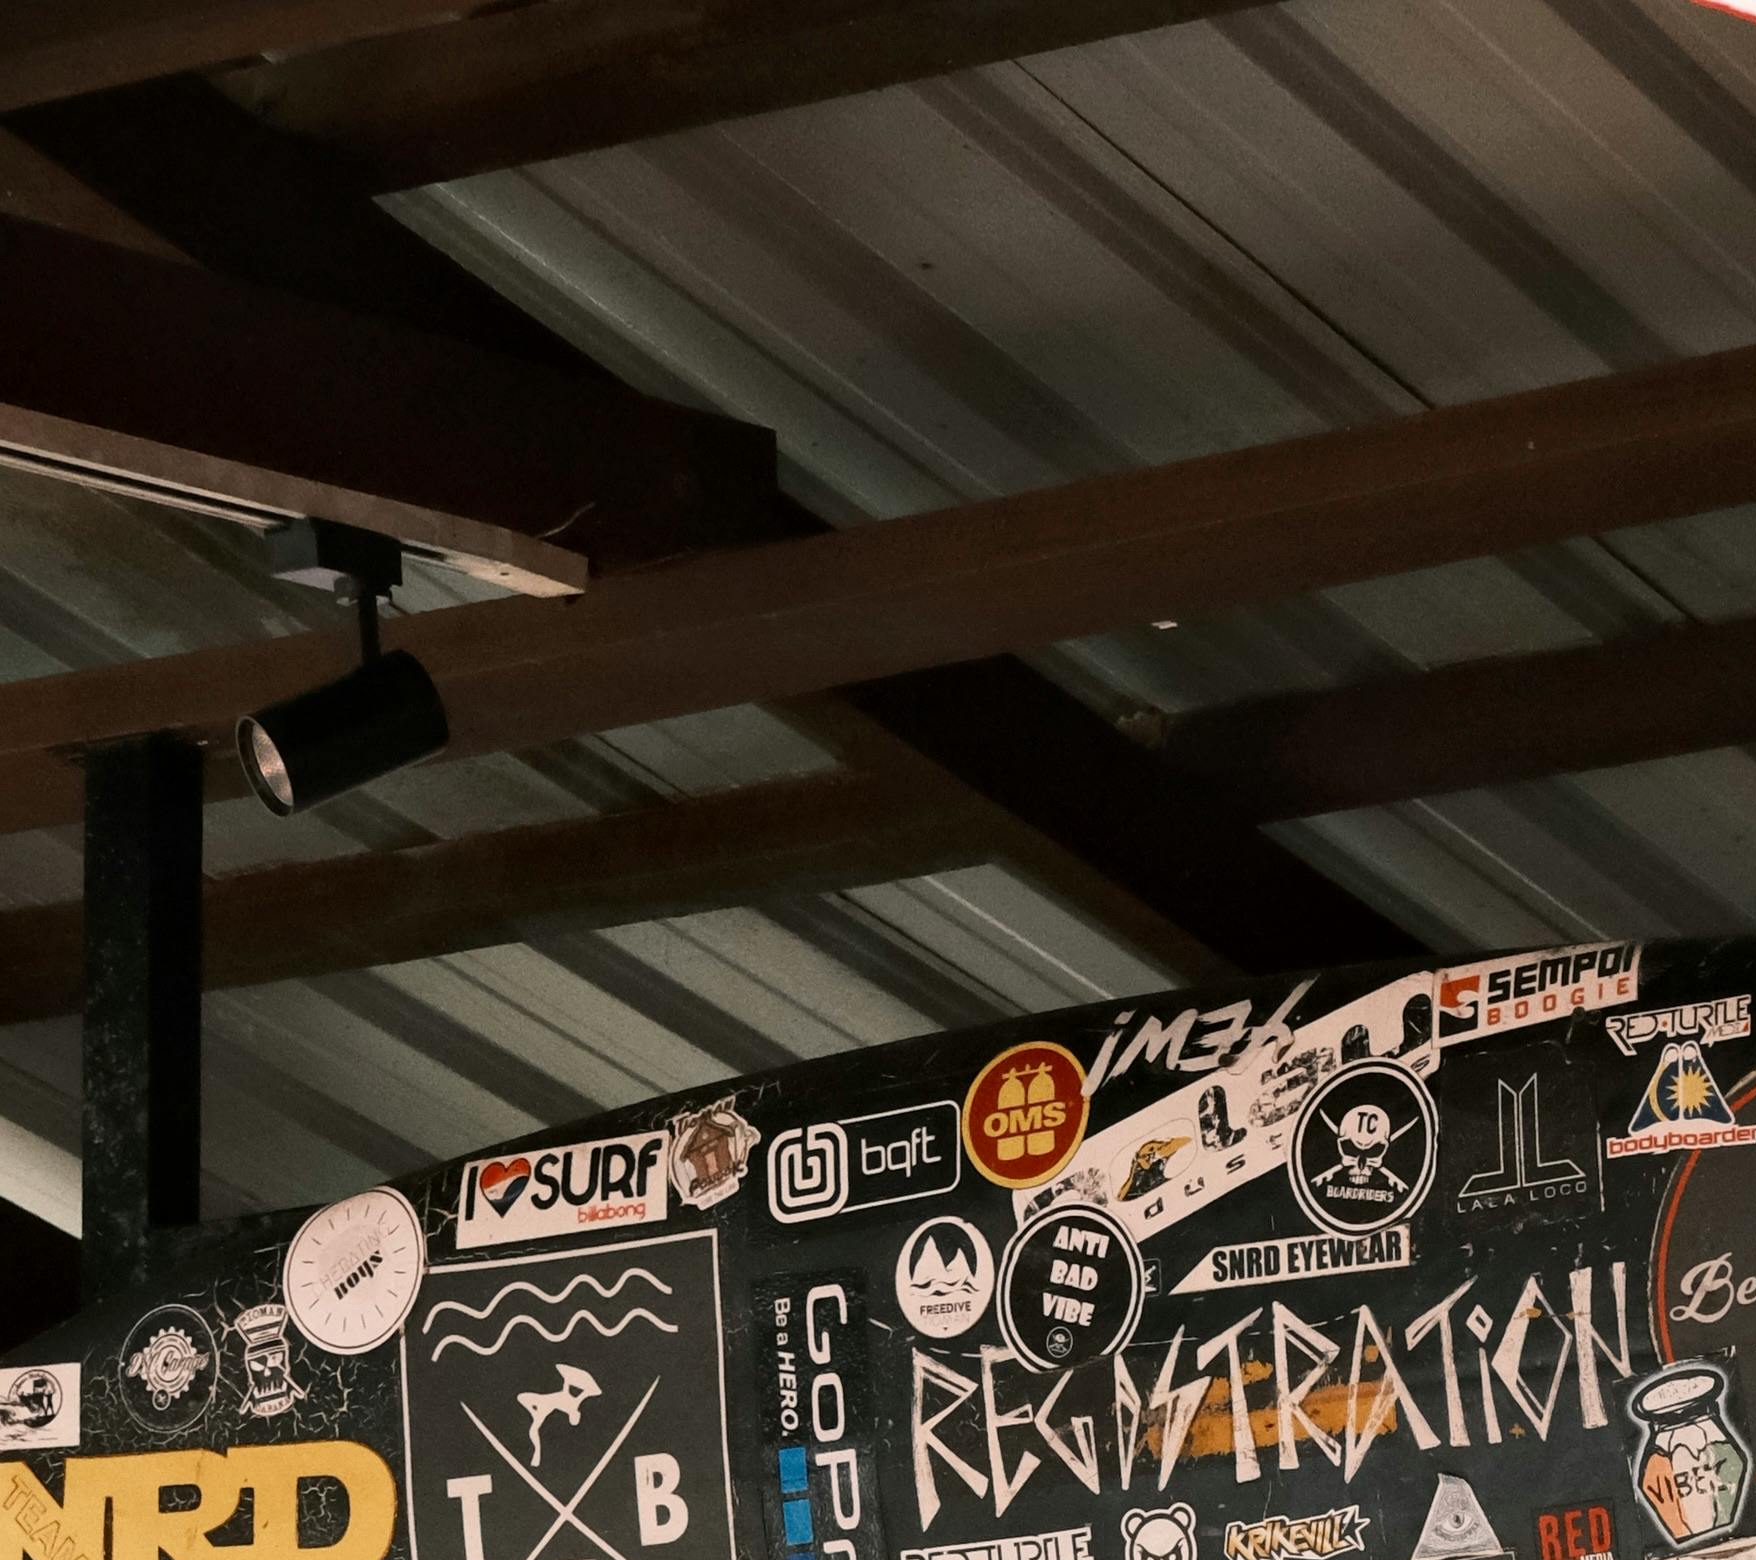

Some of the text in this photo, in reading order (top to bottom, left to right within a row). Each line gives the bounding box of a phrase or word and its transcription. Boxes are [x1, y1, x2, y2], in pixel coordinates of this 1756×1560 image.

[1487, 944, 1638, 1005] SEMPOI
[1487, 977, 1630, 1027] BOOGIE
[982, 1100, 1067, 1138] OMS
[1357, 1110, 1379, 1136] TC
[530, 1138, 663, 1211] SURF
[577, 1202, 646, 1224] billabong
[1457, 1180, 1588, 1214] LALA LOCO
[1053, 1225, 1110, 1259] ANTI
[1212, 1230, 1401, 1282] SNRD EYEWEAR
[1049, 1259, 1099, 1291] BAD
[774, 1297, 790, 1327] Be
[919, 1300, 973, 1316] FREEDIVE
[1042, 1292, 1096, 1327] VIBE
[776, 1332, 788, 1345] a
[634, 1452, 690, 1547] B
